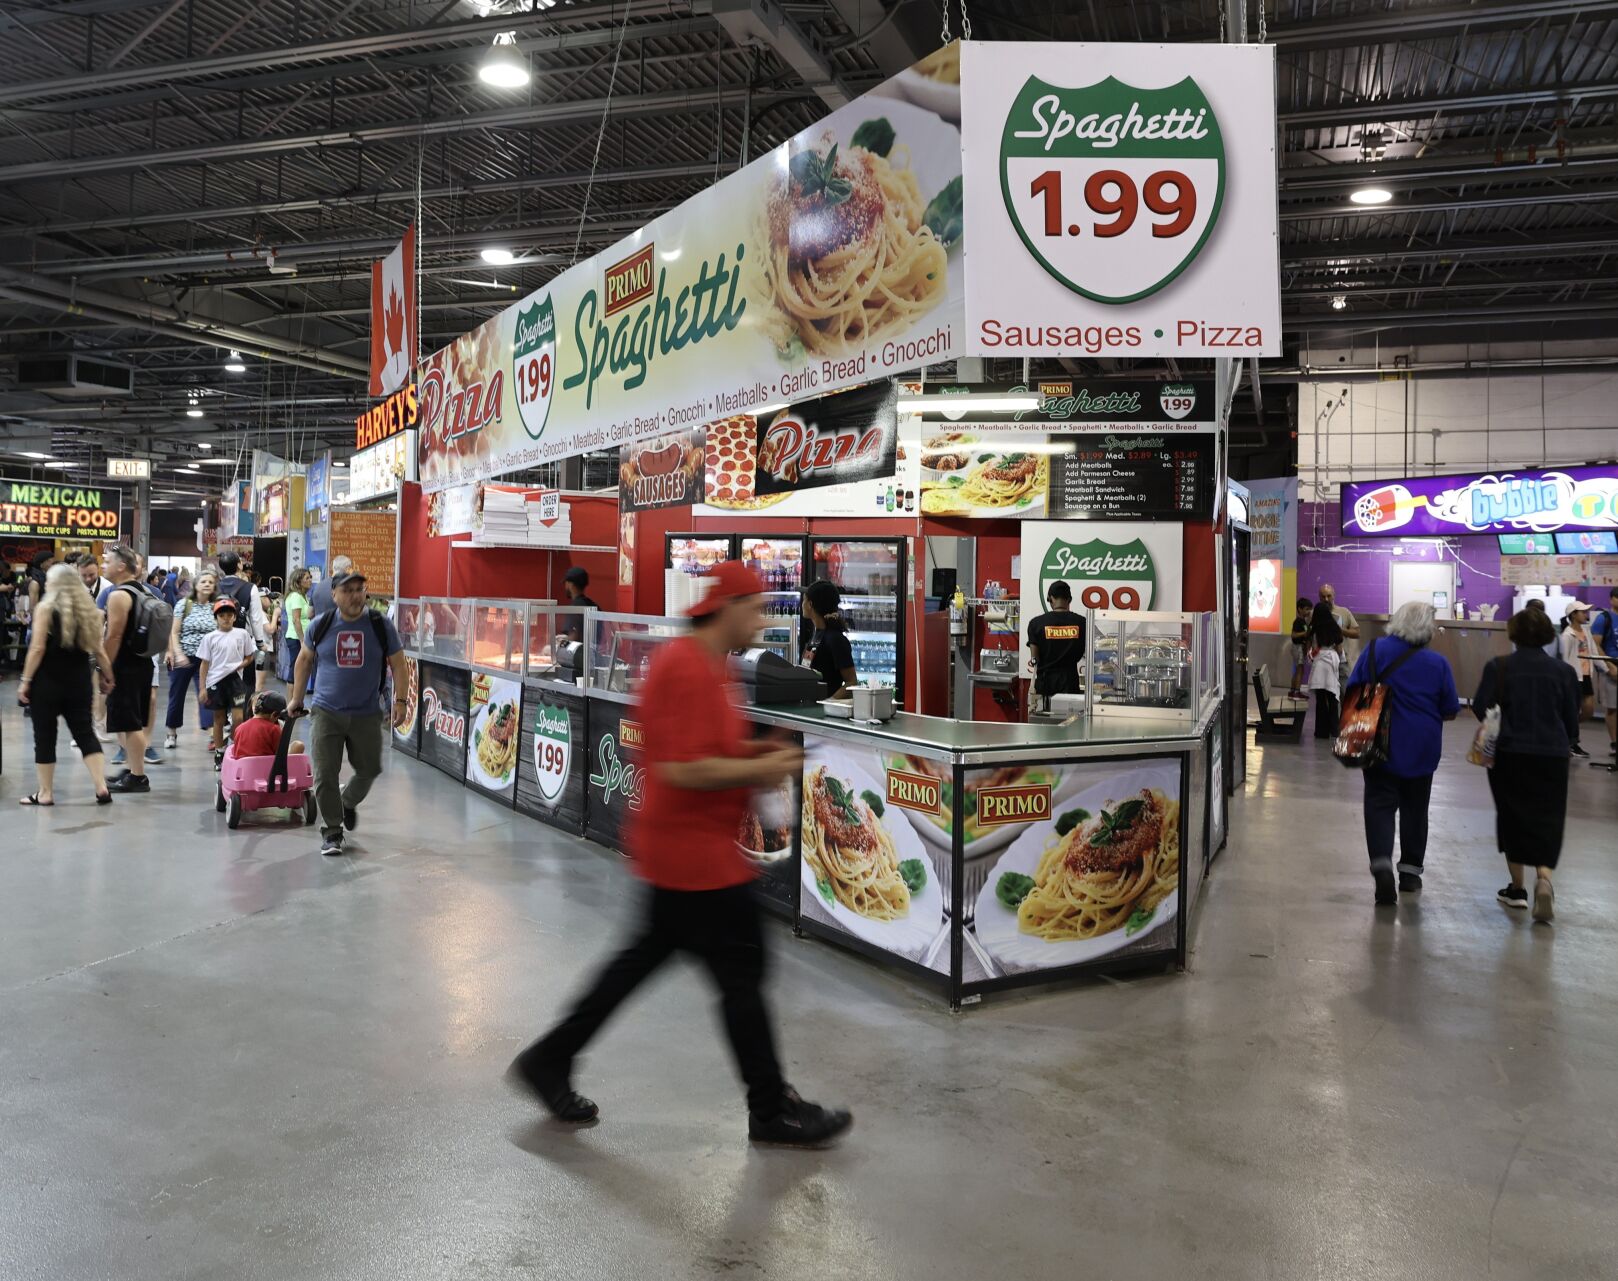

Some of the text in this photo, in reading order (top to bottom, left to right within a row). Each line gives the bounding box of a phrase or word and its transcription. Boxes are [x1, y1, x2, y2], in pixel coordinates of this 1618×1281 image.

[1013, 94, 1210, 151] Spaghetti
[1030, 169, 1198, 239] 1.99
[606, 260, 653, 308] PRIMO
[515, 310, 554, 351] Spaghetti
[562, 242, 747, 410] Spaghetti
[980, 319, 1263, 354] Sausages Pizza
[517, 353, 551, 406] 1.99
[543, 440, 568, 456] Gnocchi
[573, 428, 605, 451] Meatballs
[611, 423, 633, 440] Garlic
[634, 414, 660, 435] Bread
[667, 401, 706, 428] Gnocchi
[715, 383, 769, 415] Meatballs
[780, 366, 818, 397] Garlic
[822, 350, 866, 384] Bread
[882, 324, 951, 367] Gnocchi
[1040, 385, 1070, 395] PRIMO
[356, 383, 418, 451] HARVEY'S
[421, 367, 504, 449] Pizza
[1162, 398, 1192, 411] 1.99
[939, 424, 972, 432] Spaghetti
[1068, 424, 1102, 432] Spaghetti
[767, 419, 884, 474] Pizza
[1105, 452, 1126, 460] Med.
[1160, 452, 1172, 461] Lg.
[115, 461, 141, 476] EXIT
[11, 483, 101, 508] MEXICAN
[542, 494, 557, 506] ORDER
[634, 472, 686, 505] SAUSAGES
[1471, 478, 1559, 526] bubble
[0, 503, 118, 528] TREET FOOD
[543, 506, 555, 518] HERE
[11, 524, 31, 533] TACOS
[1251, 530, 1280, 545] UTINE
[1047, 546, 1148, 576] Spaghetti
[1081, 585, 1141, 611] 99
[1047, 627, 1078, 638] PRIMO
[474, 685, 489, 701] PRIMO
[423, 686, 465, 747] Pizza
[536, 709, 568, 736] Spaghetti
[621, 724, 646, 746] PRIMO
[536, 741, 564, 776] 1.99
[888, 774, 938, 808] PRIMO
[982, 792, 1048, 817] PRIMO
